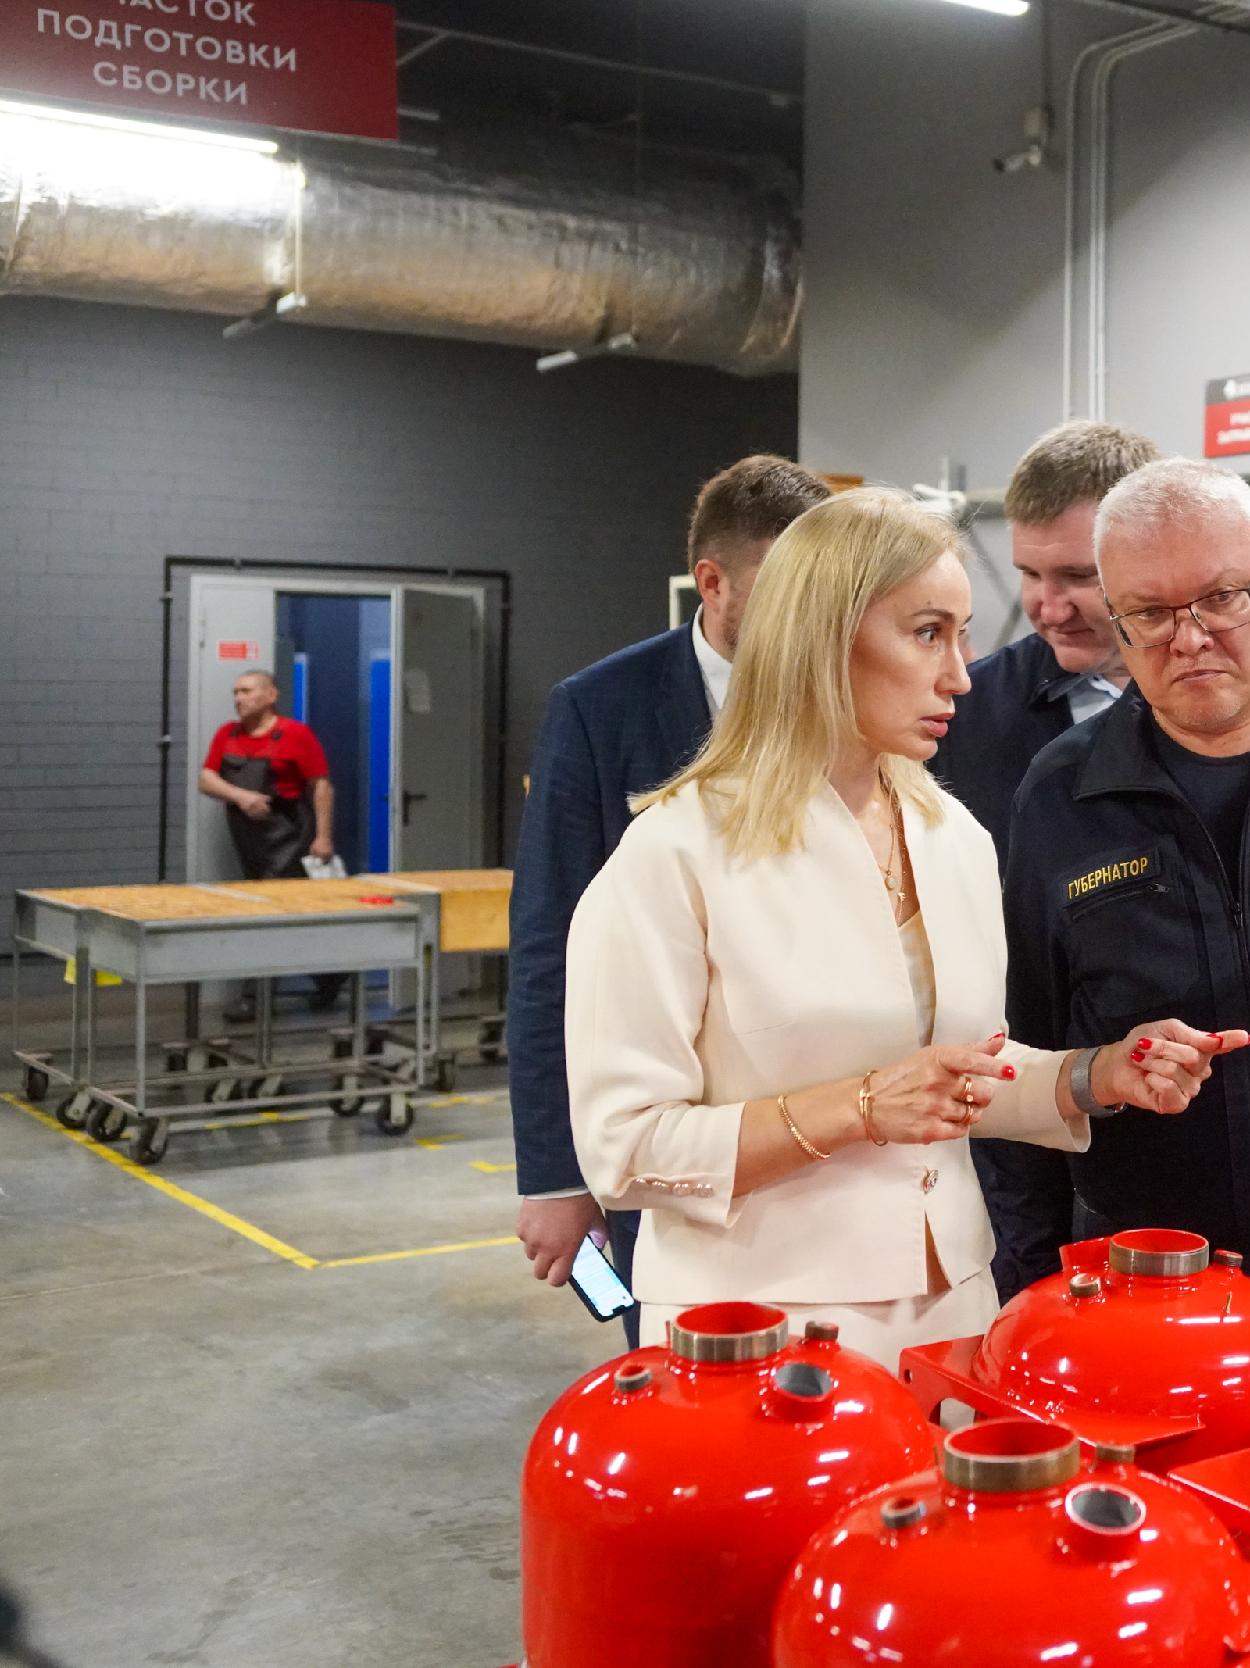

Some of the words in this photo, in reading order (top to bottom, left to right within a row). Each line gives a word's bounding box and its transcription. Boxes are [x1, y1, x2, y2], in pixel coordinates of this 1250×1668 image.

[118, 0, 256, 26] СТОК
[37, 8, 297, 72] ПОДГОТОВКИ
[93, 62, 247, 105] СБОРКИ
[1067, 857, 1149, 899] ГУБЕРНАТОР
